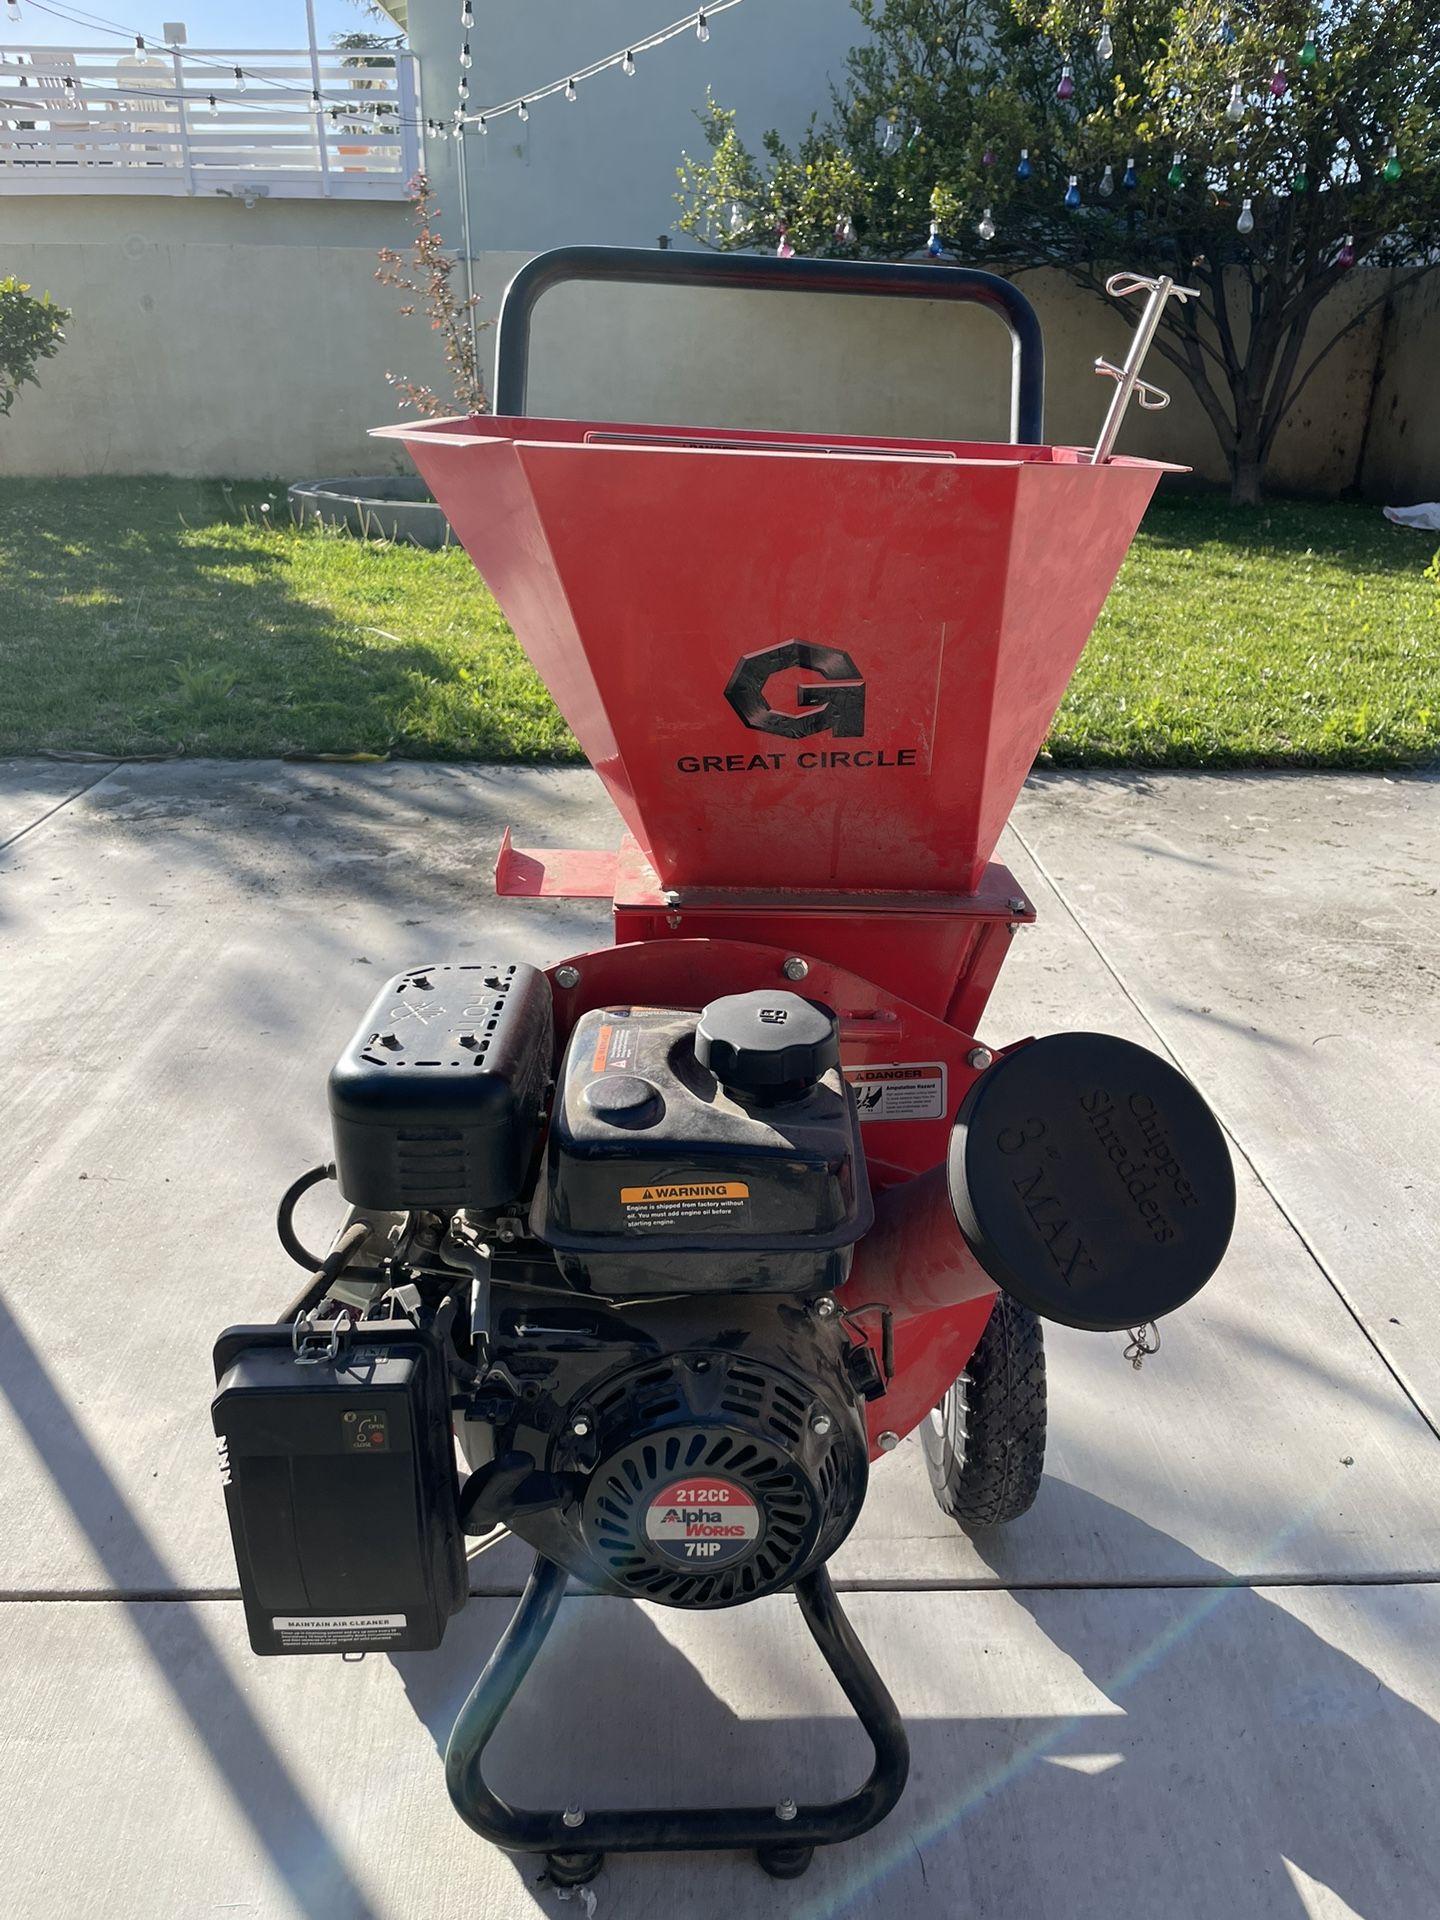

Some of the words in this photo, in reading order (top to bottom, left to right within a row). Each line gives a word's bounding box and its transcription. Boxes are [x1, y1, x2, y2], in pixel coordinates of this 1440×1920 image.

[676, 753, 786, 774] GREAT
[796, 749, 918, 769] CIRCLE
[865, 1069, 923, 1080] DANGER
[1127, 1092, 1200, 1207] Chipper
[1079, 1088, 1175, 1245] Shredders
[655, 1185, 728, 1198] WARNING
[626, 1204, 648, 1213] Engine
[656, 1202, 681, 1211] shipped
[682, 1201, 697, 1209] from
[698, 1200, 719, 1209] factory
[628, 1220, 652, 1228] starting
[653, 1218, 676, 1226] engine.
[638, 1212, 650, 1220] You
[1012, 1166, 1099, 1288] MAX
[676, 1489, 730, 1502] 212CC
[660, 1508, 722, 1526] Alpha
[686, 1523, 746, 1537] WORKS
[684, 1542, 721, 1557] 7HP
